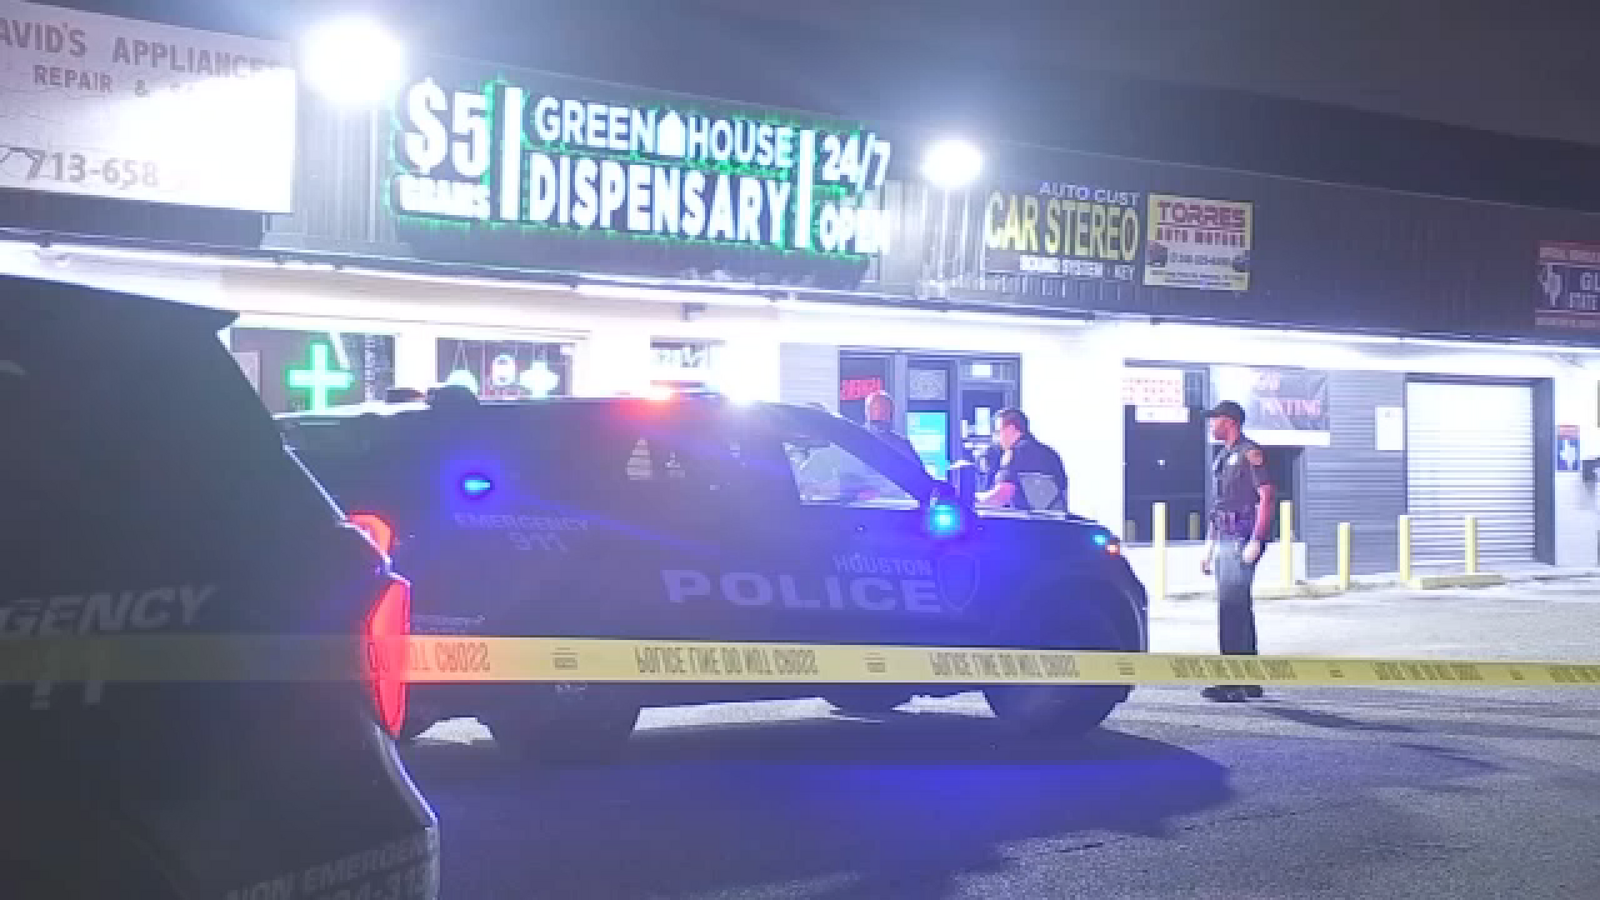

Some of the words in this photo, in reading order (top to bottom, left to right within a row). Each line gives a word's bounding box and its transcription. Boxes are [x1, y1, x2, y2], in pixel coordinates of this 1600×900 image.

[112, 37, 282, 78] APPLIANCE
[34, 65, 113, 94] REPAIR
[135, 80, 149, 97] &
[404, 77, 491, 175] $5
[534, 97, 657, 153] GREEN
[688, 116, 794, 168] HOUSE
[822, 132, 891, 194] 24/7
[529, 152, 792, 247] DISPENSARY
[1039, 182, 1091, 200] AUTO
[984, 191, 1040, 251] CAR
[1044, 199, 1140, 261] STEREO
[1157, 200, 1246, 228] TORRES
[453, 512, 589, 530] EMERGENCY
[508, 531, 569, 553] 911
[832, 553, 933, 577] HOUSTON
[0, 584, 219, 636] GENCY
[660, 569, 942, 613] POLICE
